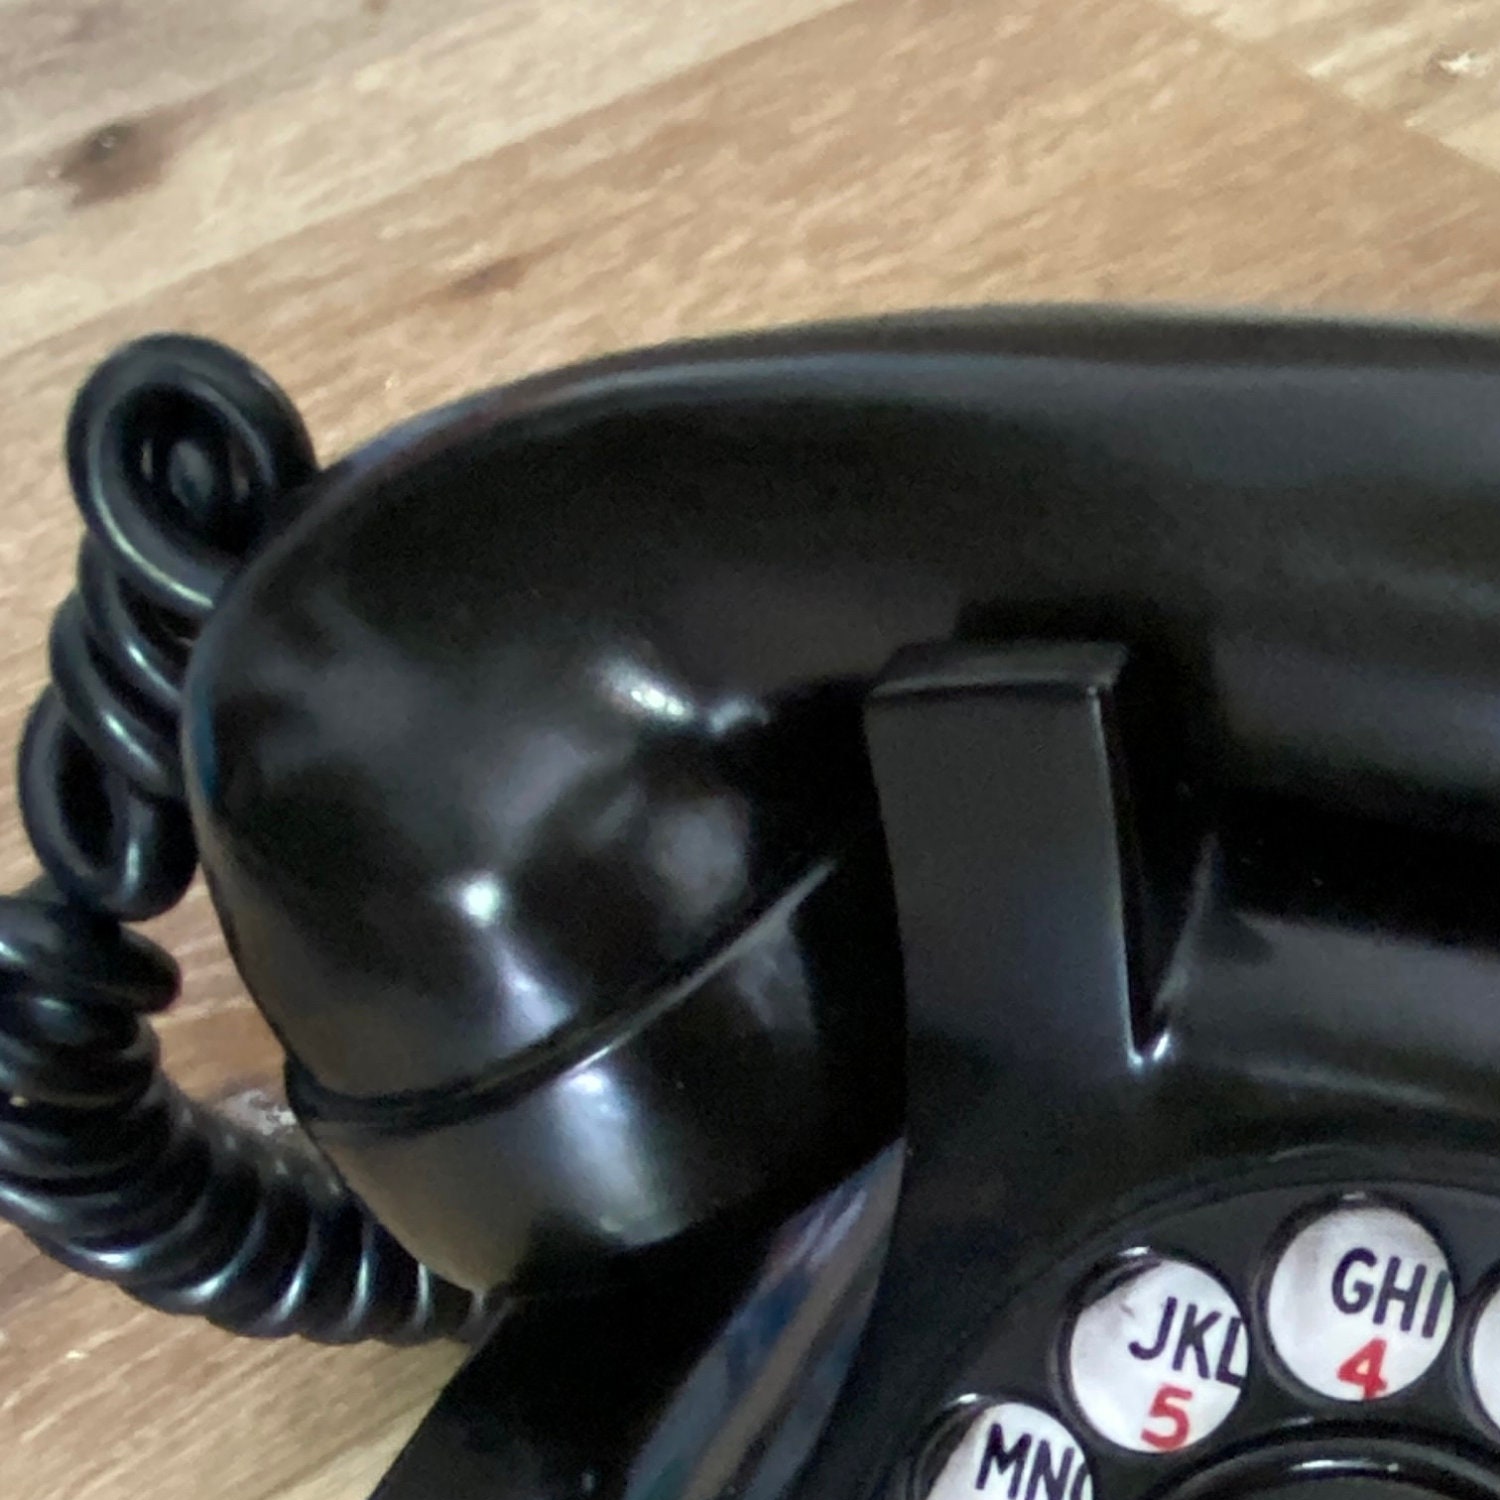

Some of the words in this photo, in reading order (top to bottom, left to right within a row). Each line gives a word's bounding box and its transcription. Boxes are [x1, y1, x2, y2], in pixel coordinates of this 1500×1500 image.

[1331, 1247, 1451, 1338] GHI
[1128, 1296, 1245, 1389] JKL
[1336, 1338, 1388, 1400] 4
[1140, 1384, 1193, 1451] 5
